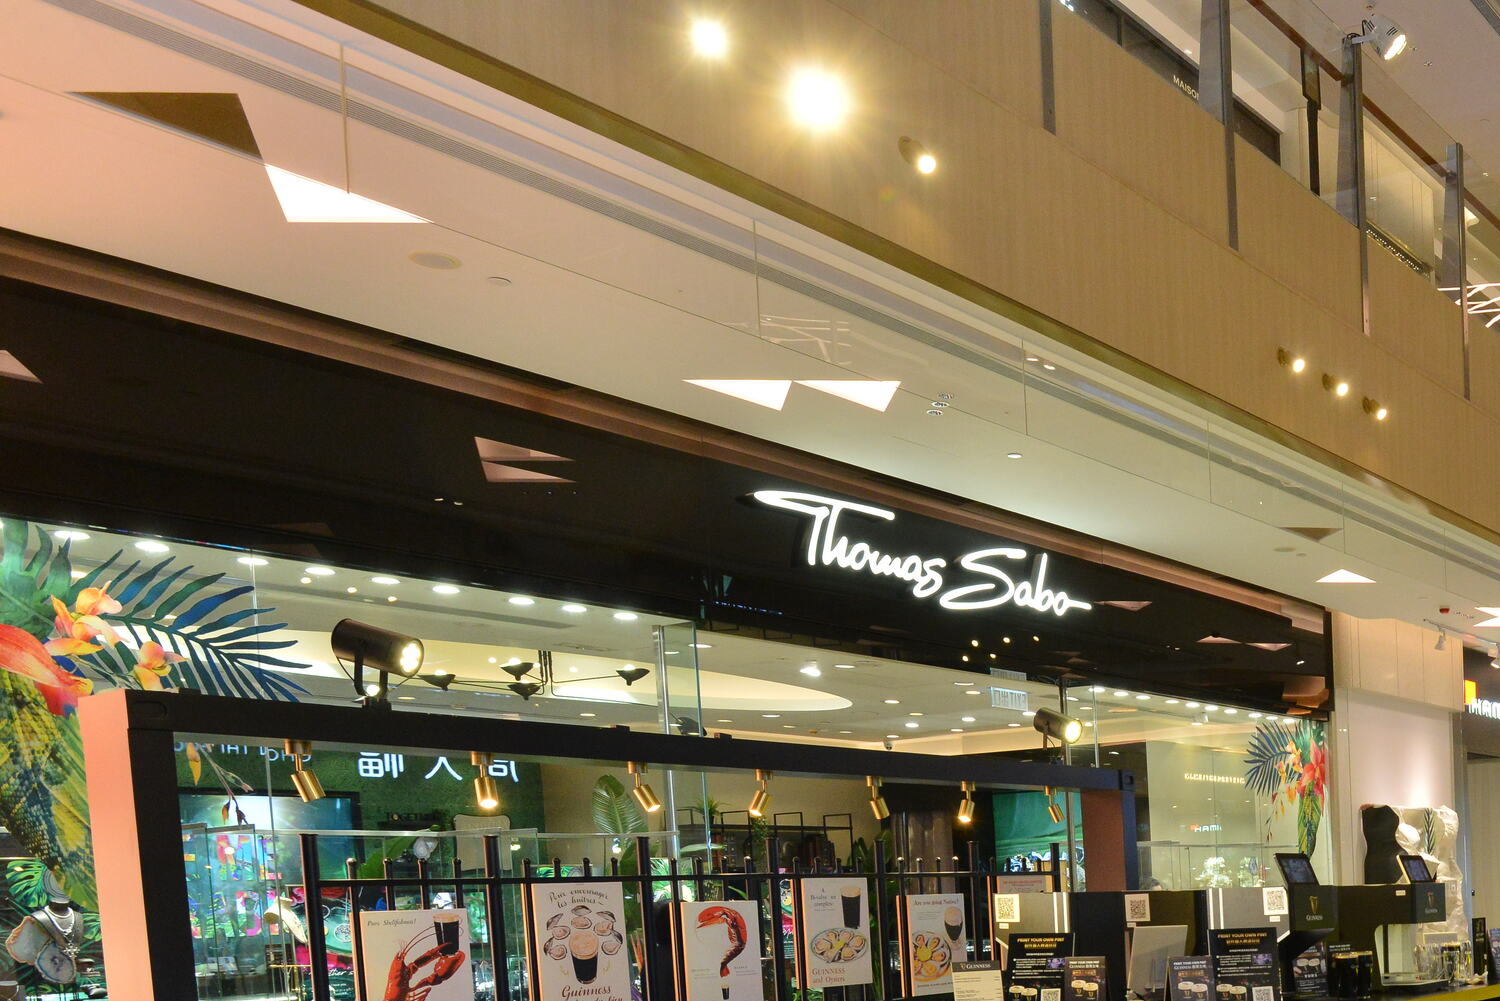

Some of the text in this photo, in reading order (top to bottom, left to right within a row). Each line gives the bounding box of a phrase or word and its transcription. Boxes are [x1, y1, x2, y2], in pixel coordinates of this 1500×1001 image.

[1173, 75, 1199, 100] MAISO
[754, 490, 1092, 616] Thomas Sabo
[812, 967, 845, 976] GUINNESS
[562, 985, 611, 998] Guinness
